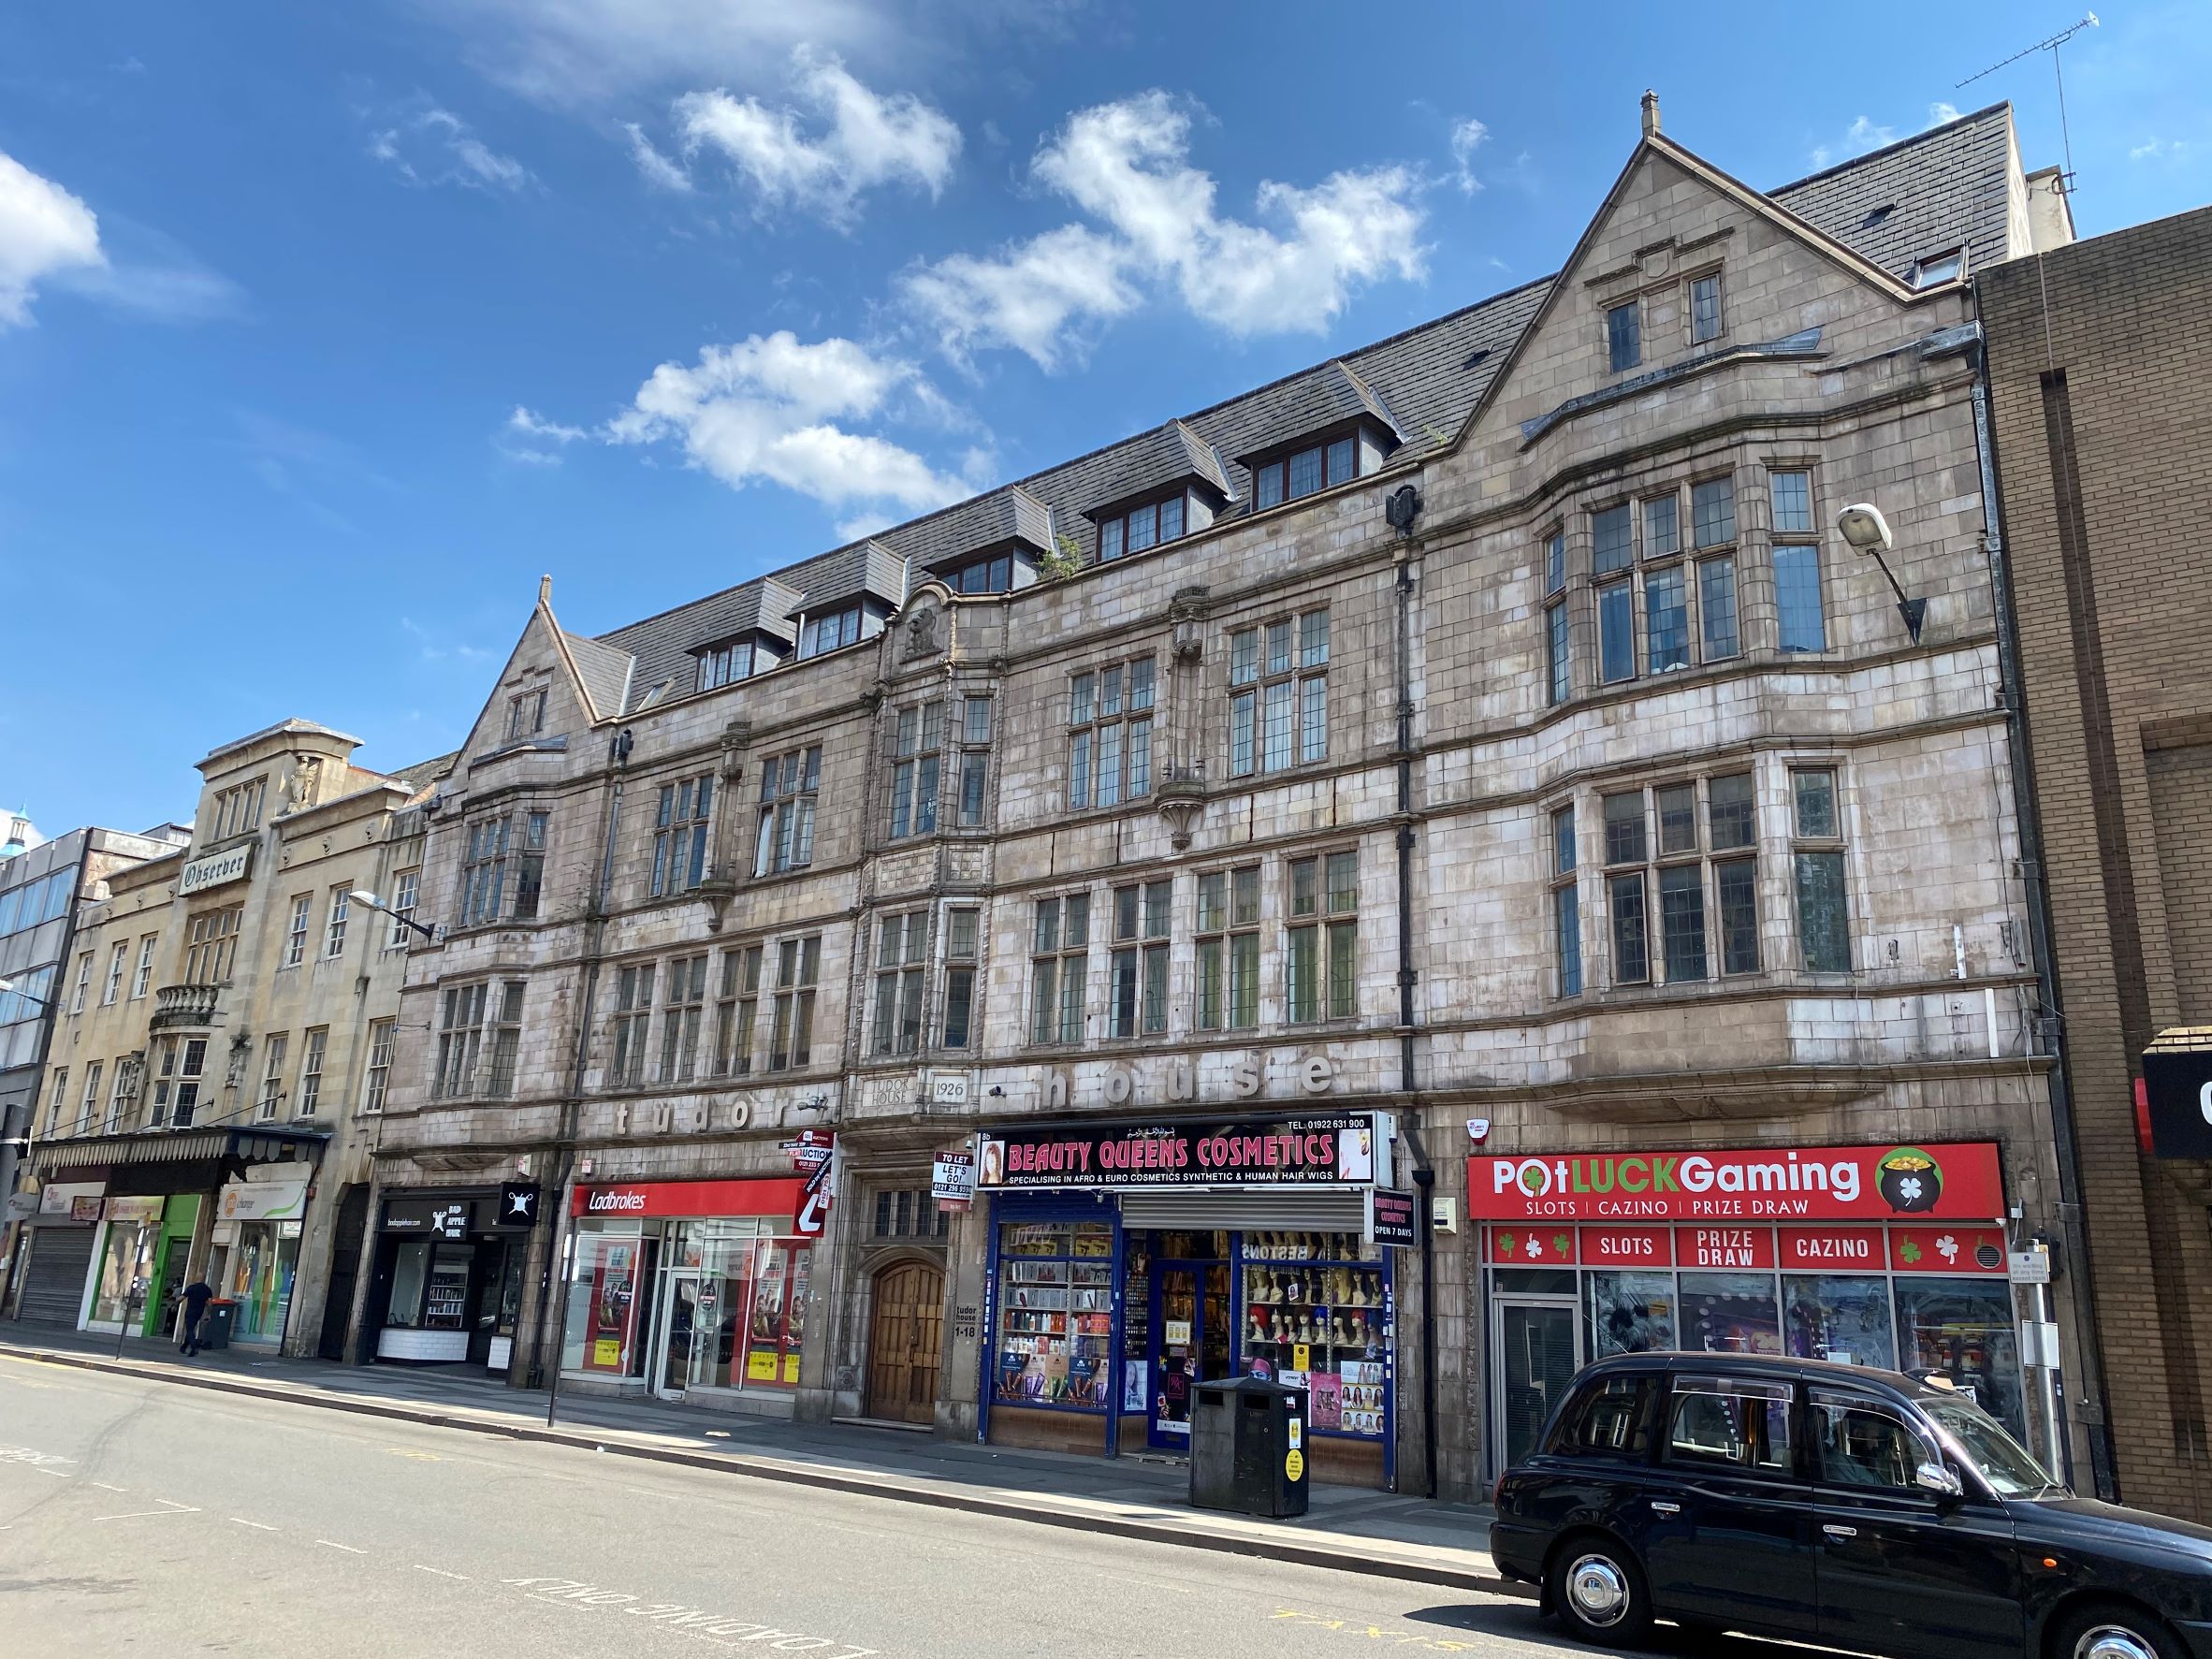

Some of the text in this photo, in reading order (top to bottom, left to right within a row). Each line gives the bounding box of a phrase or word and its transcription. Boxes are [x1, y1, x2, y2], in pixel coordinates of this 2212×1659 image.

[185, 856, 243, 888] Observer
[872, 1078, 908, 1092] TUDOR
[1041, 1055, 1332, 1107] house
[937, 1083, 964, 1096] 1926
[872, 1090, 907, 1104] HOUSE
[617, 1096, 790, 1135] tudor
[1307, 1120, 1332, 1129] 01922
[1332, 1120, 1347, 1128] 631
[1348, 1119, 1364, 1128] 900
[942, 1154, 968, 1164] TO LET
[1008, 1134, 1333, 1173] BEAUTY QUEENS COSMETICS
[942, 1165, 968, 1175] LET'S
[946, 1173, 963, 1184] GO!
[1009, 1176, 1061, 1185] SPECIALISING
[1131, 1173, 1181, 1182] COSMETICS
[1183, 1172, 1232, 1181] SYNTHETIC
[1235, 1172, 1242, 1181] &
[1244, 1171, 1279, 1181] HUMAN
[1281, 1171, 1304, 1180] HAIR
[1308, 1171, 1333, 1180] WIGS
[589, 1190, 647, 1210] Ladbrokes
[448, 1205, 462, 1215] BAD
[1526, 1200, 1809, 1215] SLOTS CAZINO PRIZE DRAW
[446, 1217, 466, 1226] APPLE
[1375, 1226, 1412, 1237] OPEN 7 DAYS
[1696, 1230, 1754, 1247] PRIZE
[1600, 1237, 1653, 1255] SLOTS
[1797, 1239, 1869, 1258] CAZINO
[1697, 1248, 1754, 1266] DRAW
[956, 1306, 976, 1315] tudor
[955, 1326, 975, 1337] 1-18
